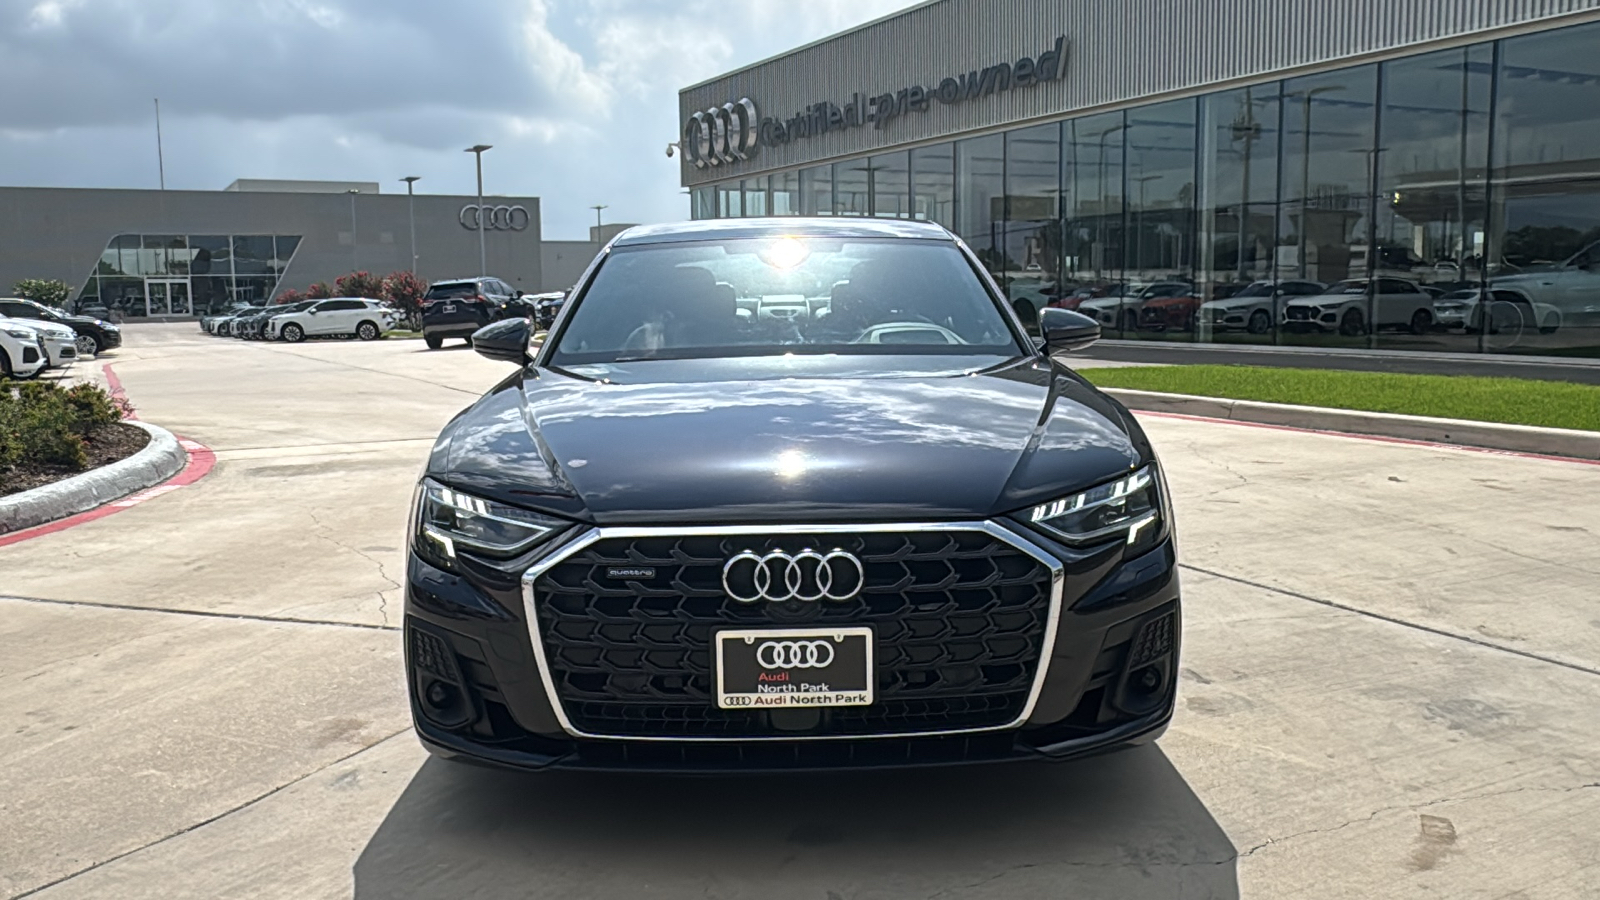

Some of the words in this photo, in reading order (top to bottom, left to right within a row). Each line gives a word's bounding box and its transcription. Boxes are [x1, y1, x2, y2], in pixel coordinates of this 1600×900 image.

[760, 92, 866, 148] Certified
[758, 671, 789, 682] Audi
[757, 683, 797, 693] North
[800, 682, 830, 692] Park
[754, 695, 787, 706] Audi
[790, 694, 833, 704] North
[835, 693, 867, 703] Park
